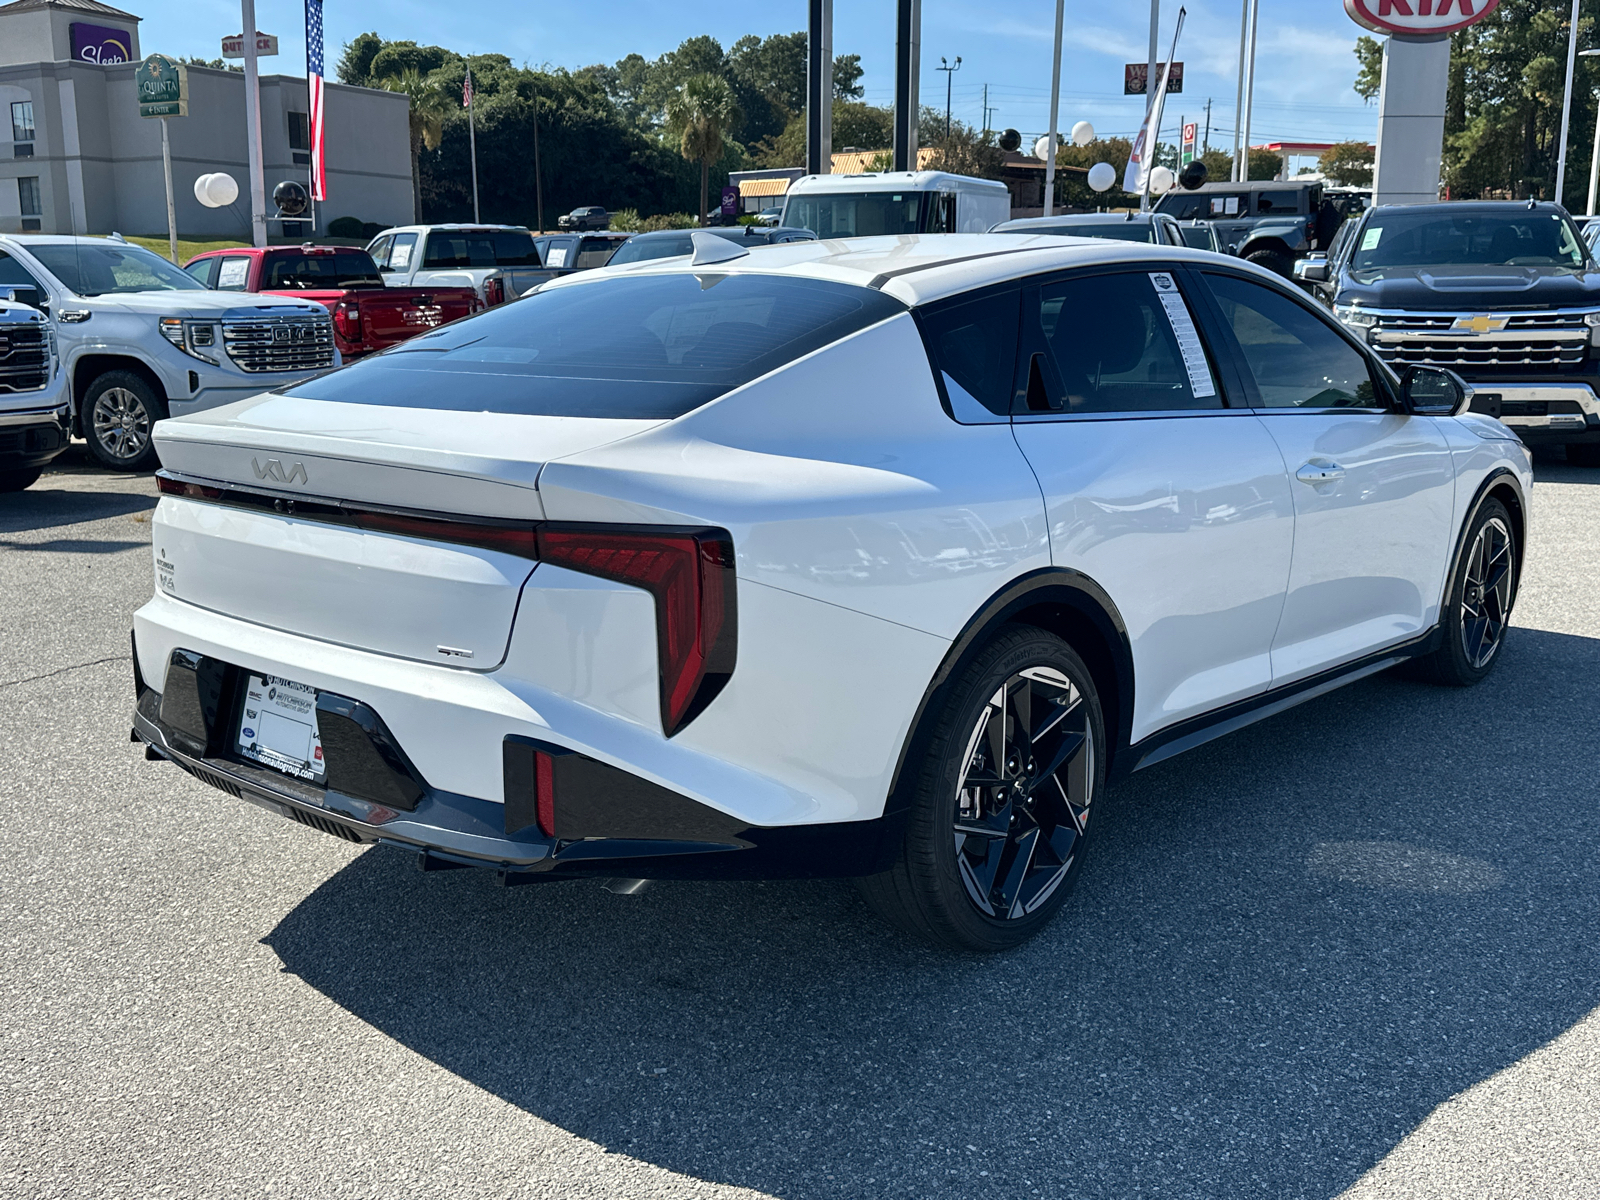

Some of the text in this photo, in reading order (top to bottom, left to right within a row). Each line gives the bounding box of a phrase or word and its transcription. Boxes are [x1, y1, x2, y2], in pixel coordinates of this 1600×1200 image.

[222, 39, 270, 52] OUTCK
[143, 80, 177, 95] QUINTA
[153, 106, 170, 115] ENTER
[273, 675, 315, 695] HUTCHINSON
[248, 690, 263, 699] GMC
[275, 692, 313, 710] HUTCHINSON
[296, 705, 310, 715] GROUP
